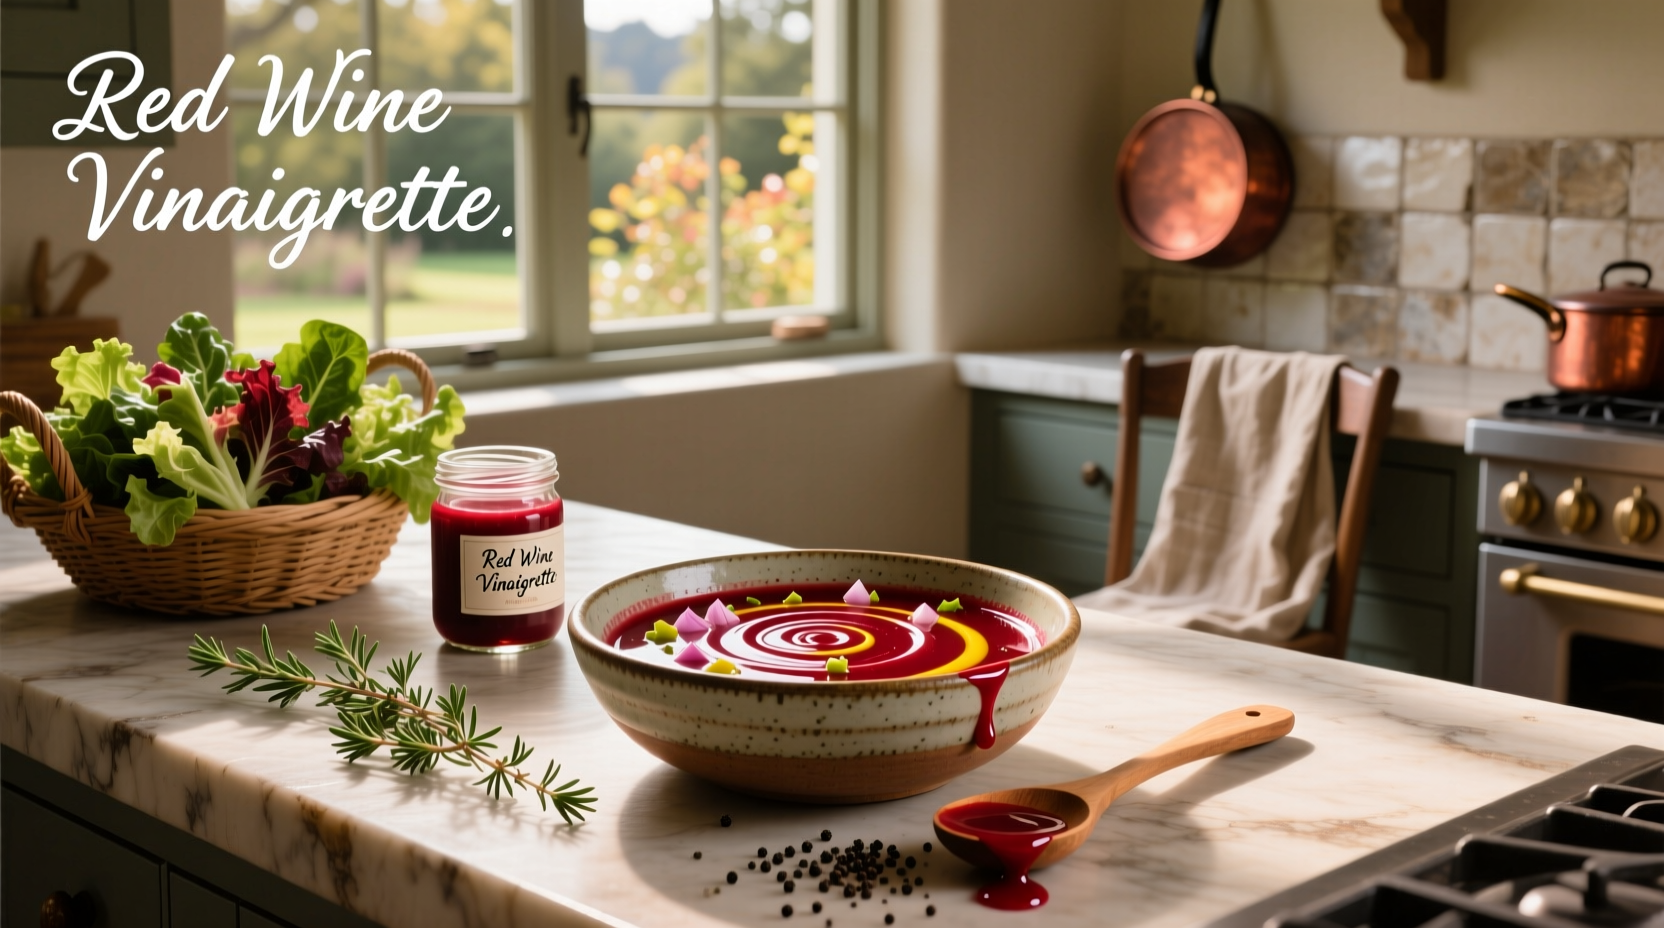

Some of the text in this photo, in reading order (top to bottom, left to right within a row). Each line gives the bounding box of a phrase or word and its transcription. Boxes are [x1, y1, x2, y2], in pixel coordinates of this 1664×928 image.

[482, 545, 554, 569] Red Wine
[475, 567, 558, 598] Vinaigrette
